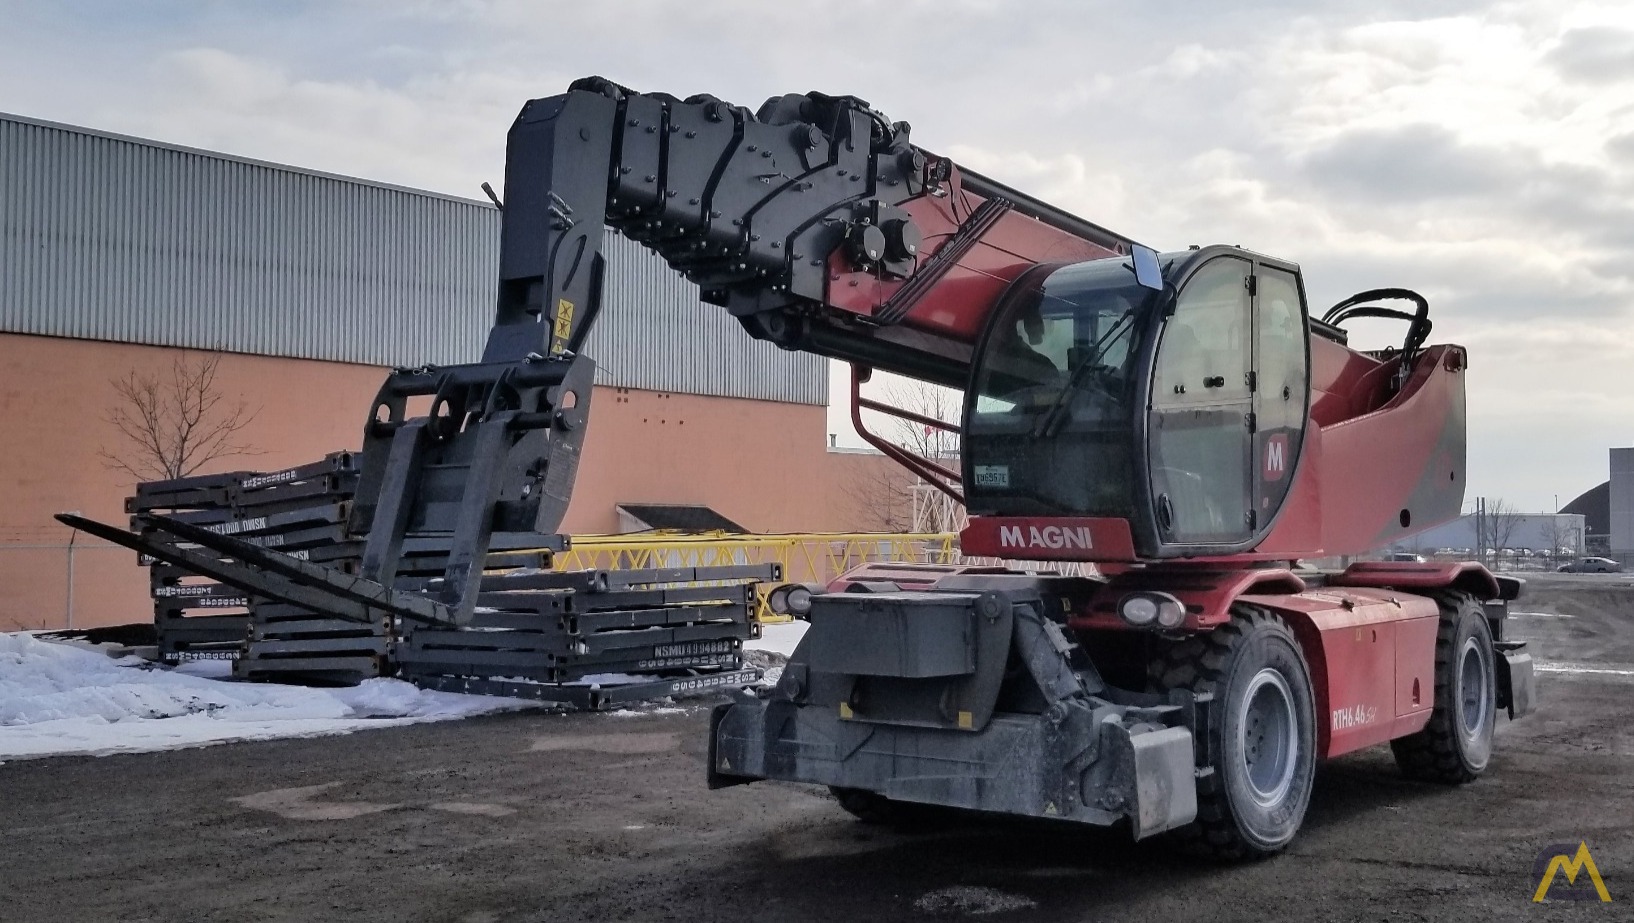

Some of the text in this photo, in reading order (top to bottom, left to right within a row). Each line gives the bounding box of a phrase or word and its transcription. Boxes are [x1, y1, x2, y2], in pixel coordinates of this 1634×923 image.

[1267, 442, 1283, 471] M
[242, 516, 267, 532] NSMU
[1000, 525, 1093, 549] MAGNI
[1333, 704, 1365, 730] RTH6.46
